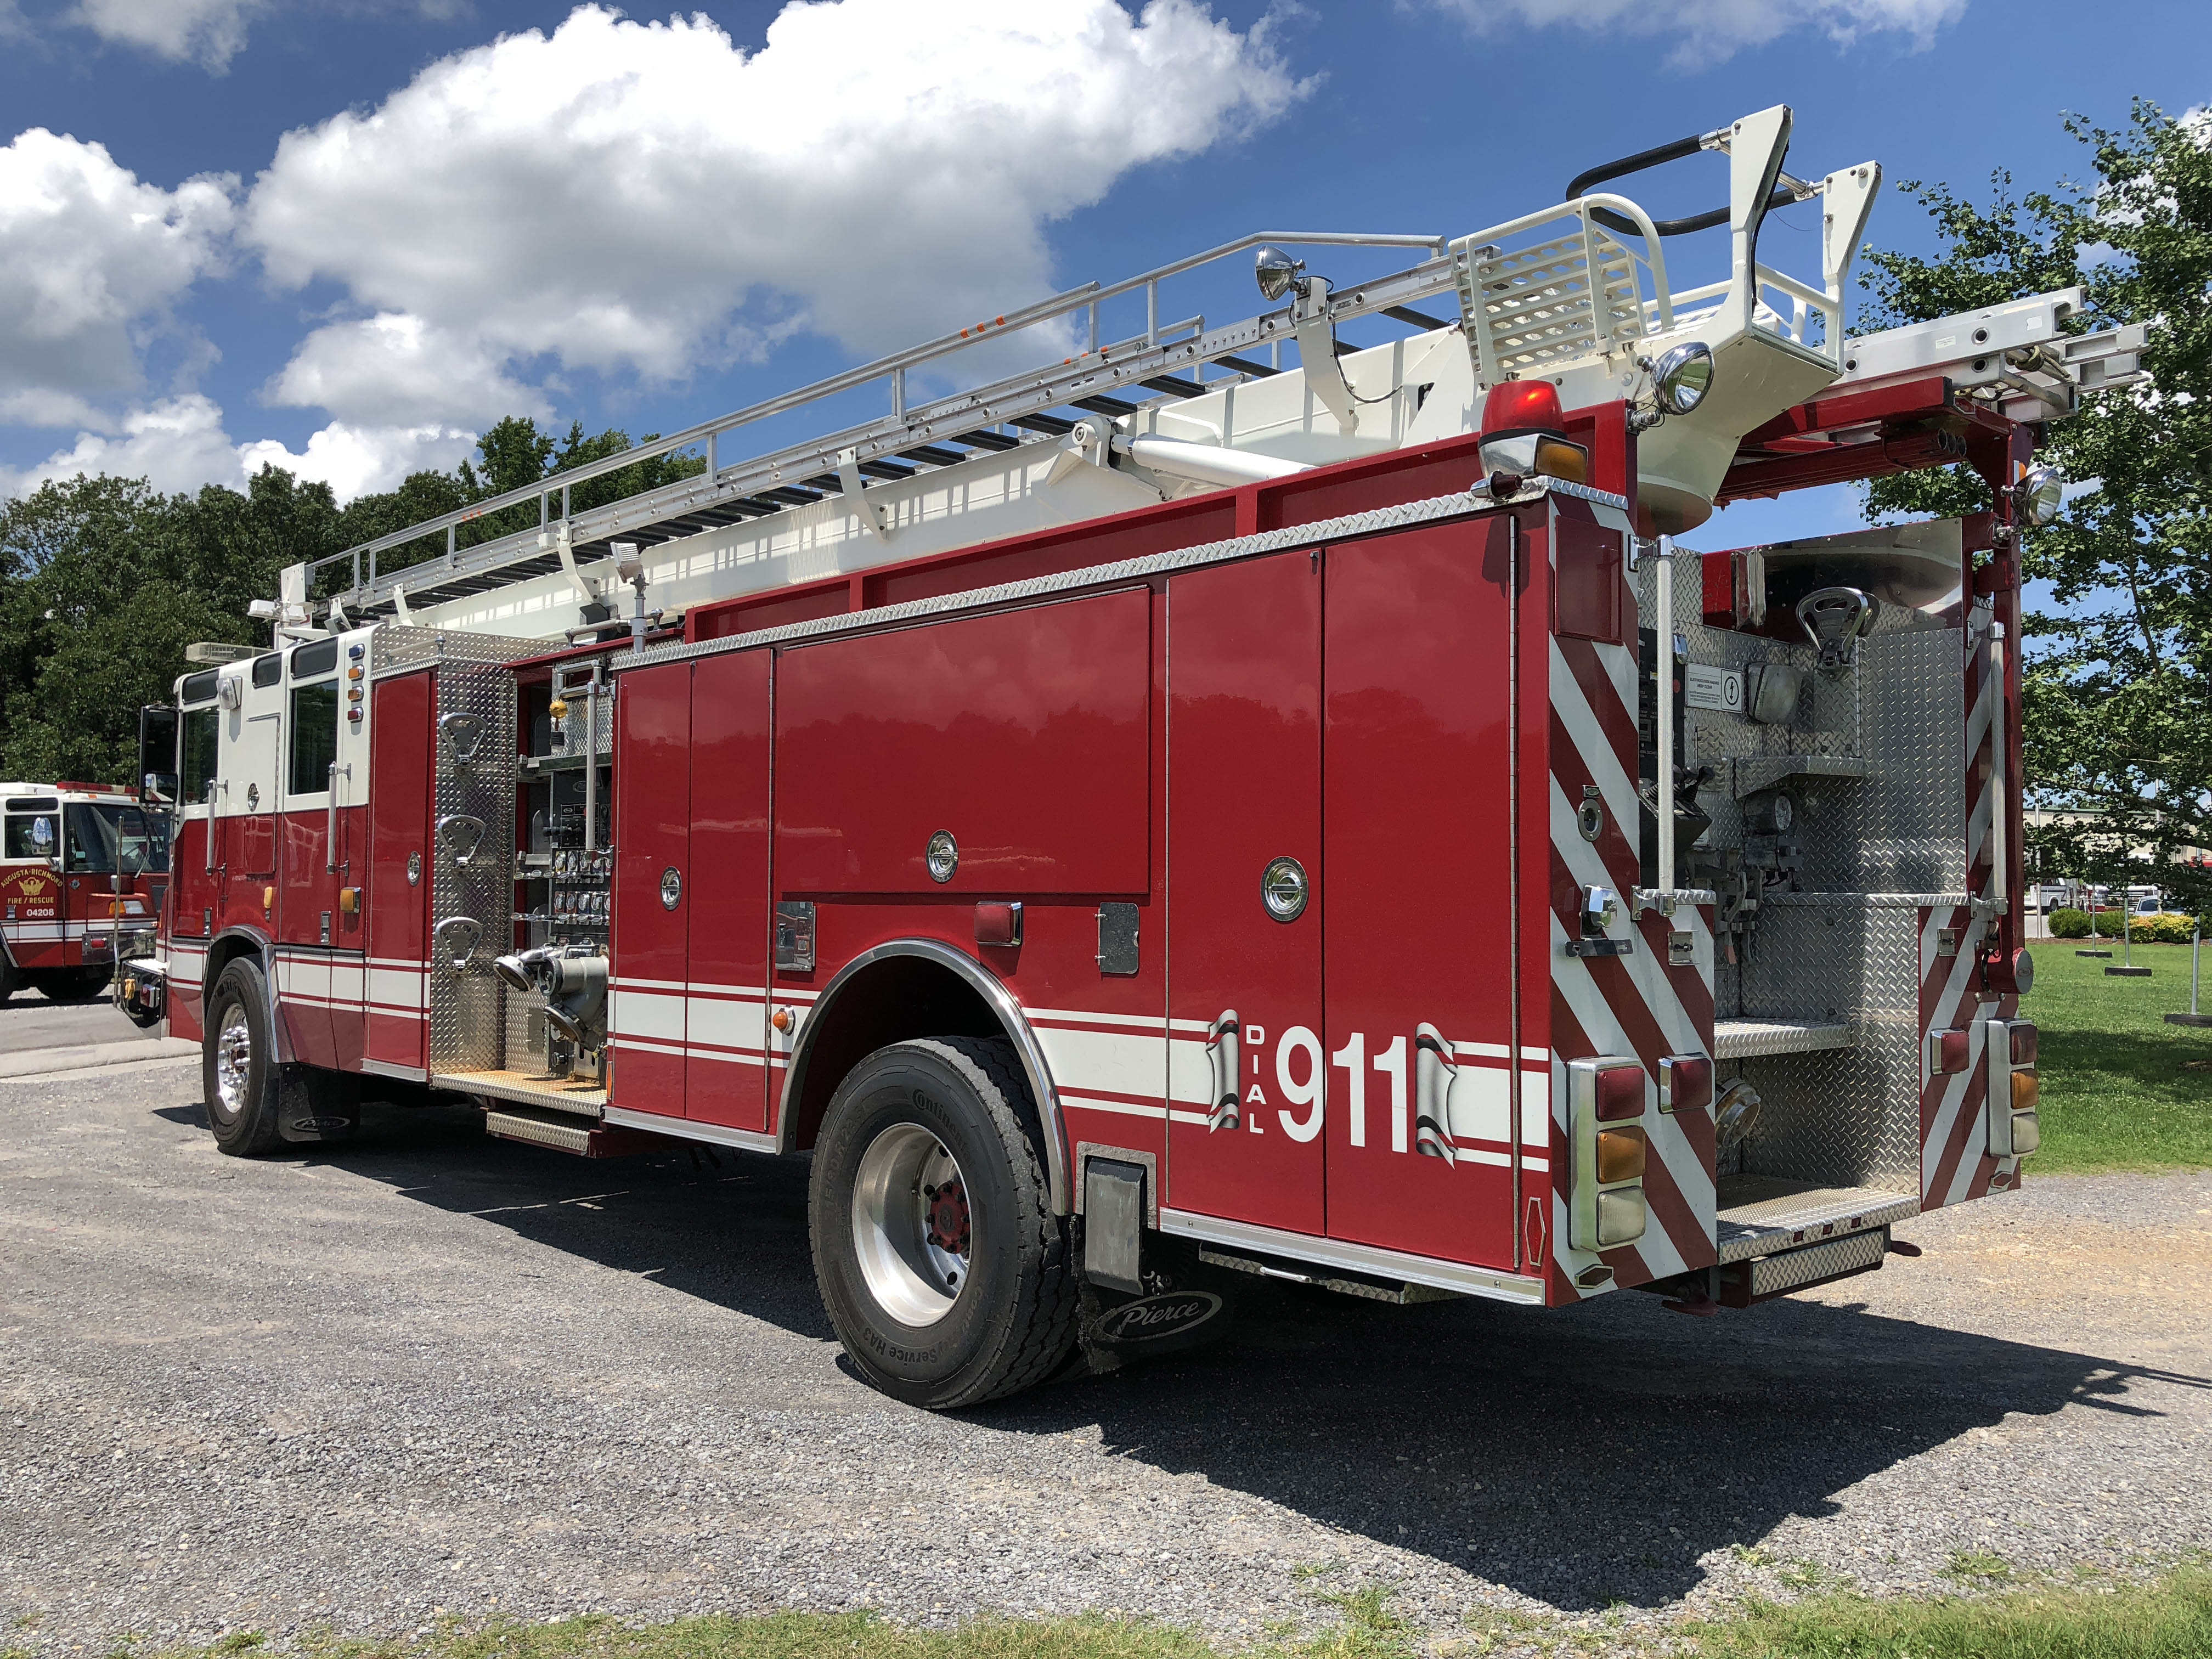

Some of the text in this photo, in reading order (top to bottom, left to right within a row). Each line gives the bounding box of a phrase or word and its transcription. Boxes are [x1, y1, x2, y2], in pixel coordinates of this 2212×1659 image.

[26, 908, 54, 917] 04208
[1246, 1024, 1267, 1134] DIAL
[1276, 1025, 1408, 1153] 911
[1117, 1302, 1200, 1332] Pierce
